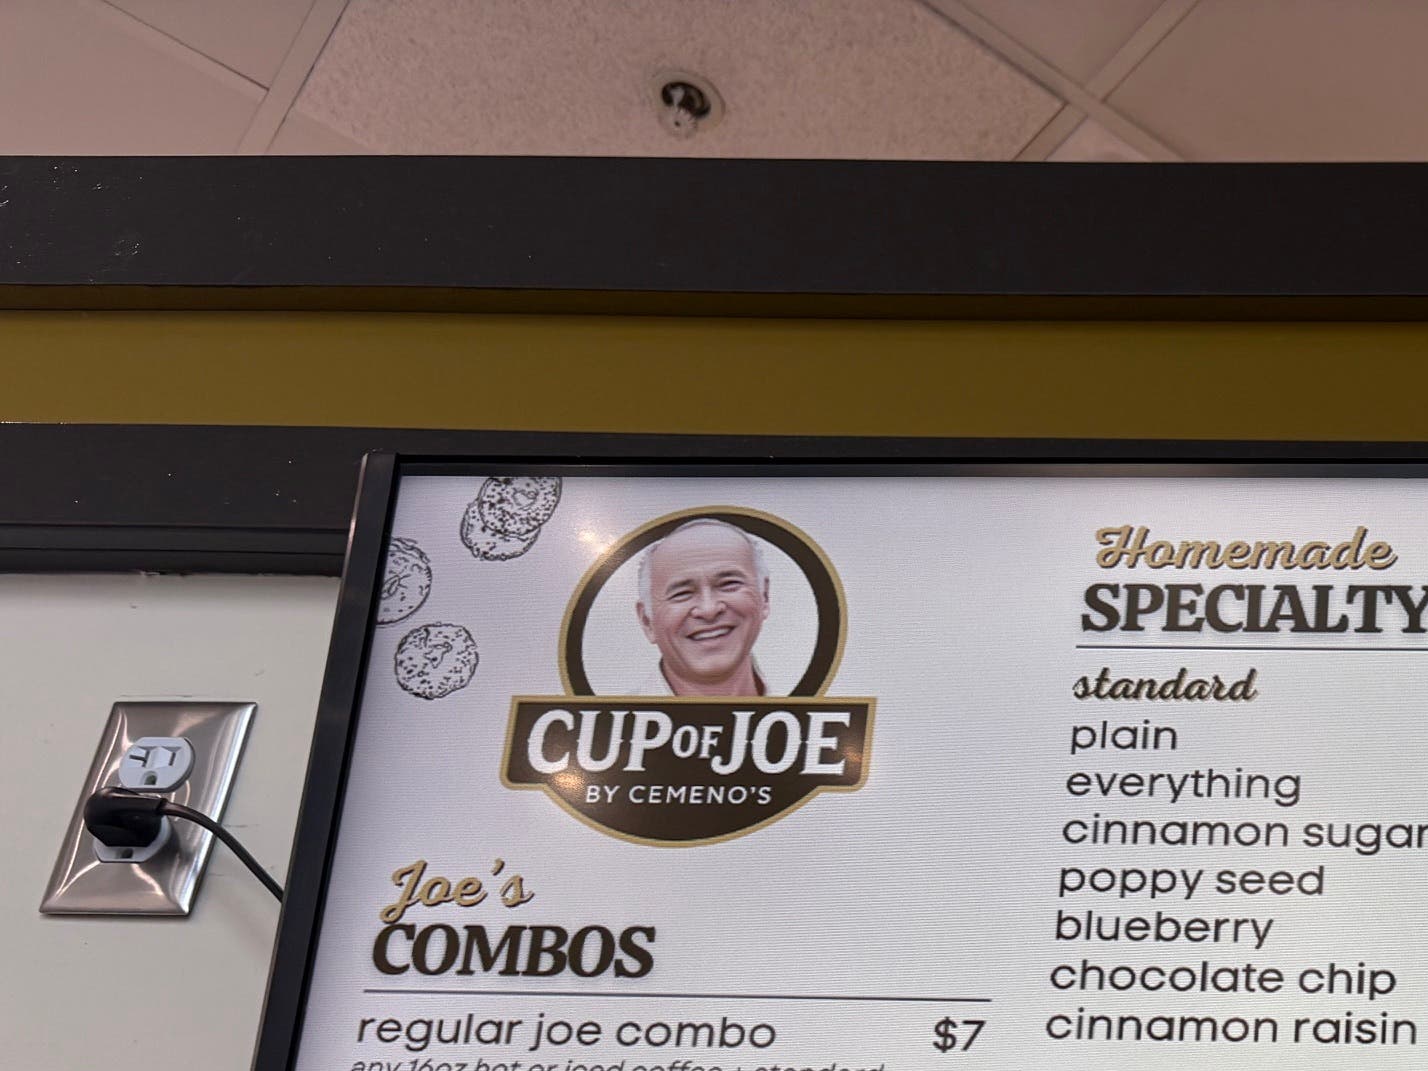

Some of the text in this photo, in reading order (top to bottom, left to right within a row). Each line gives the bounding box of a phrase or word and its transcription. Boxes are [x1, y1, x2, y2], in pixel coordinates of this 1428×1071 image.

[1094, 524, 1399, 570] Homemade
[1071, 666, 1259, 702] standard
[526, 708, 852, 777] CUP OF JOE
[1070, 718, 1178, 756] plain
[585, 785, 773, 806] BY CEMENO'S
[1065, 766, 1301, 808] everything
[378, 857, 535, 924] Joe's
[371, 922, 657, 978] COMBOS
[357, 1012, 987, 1054] regular joe combo $7
